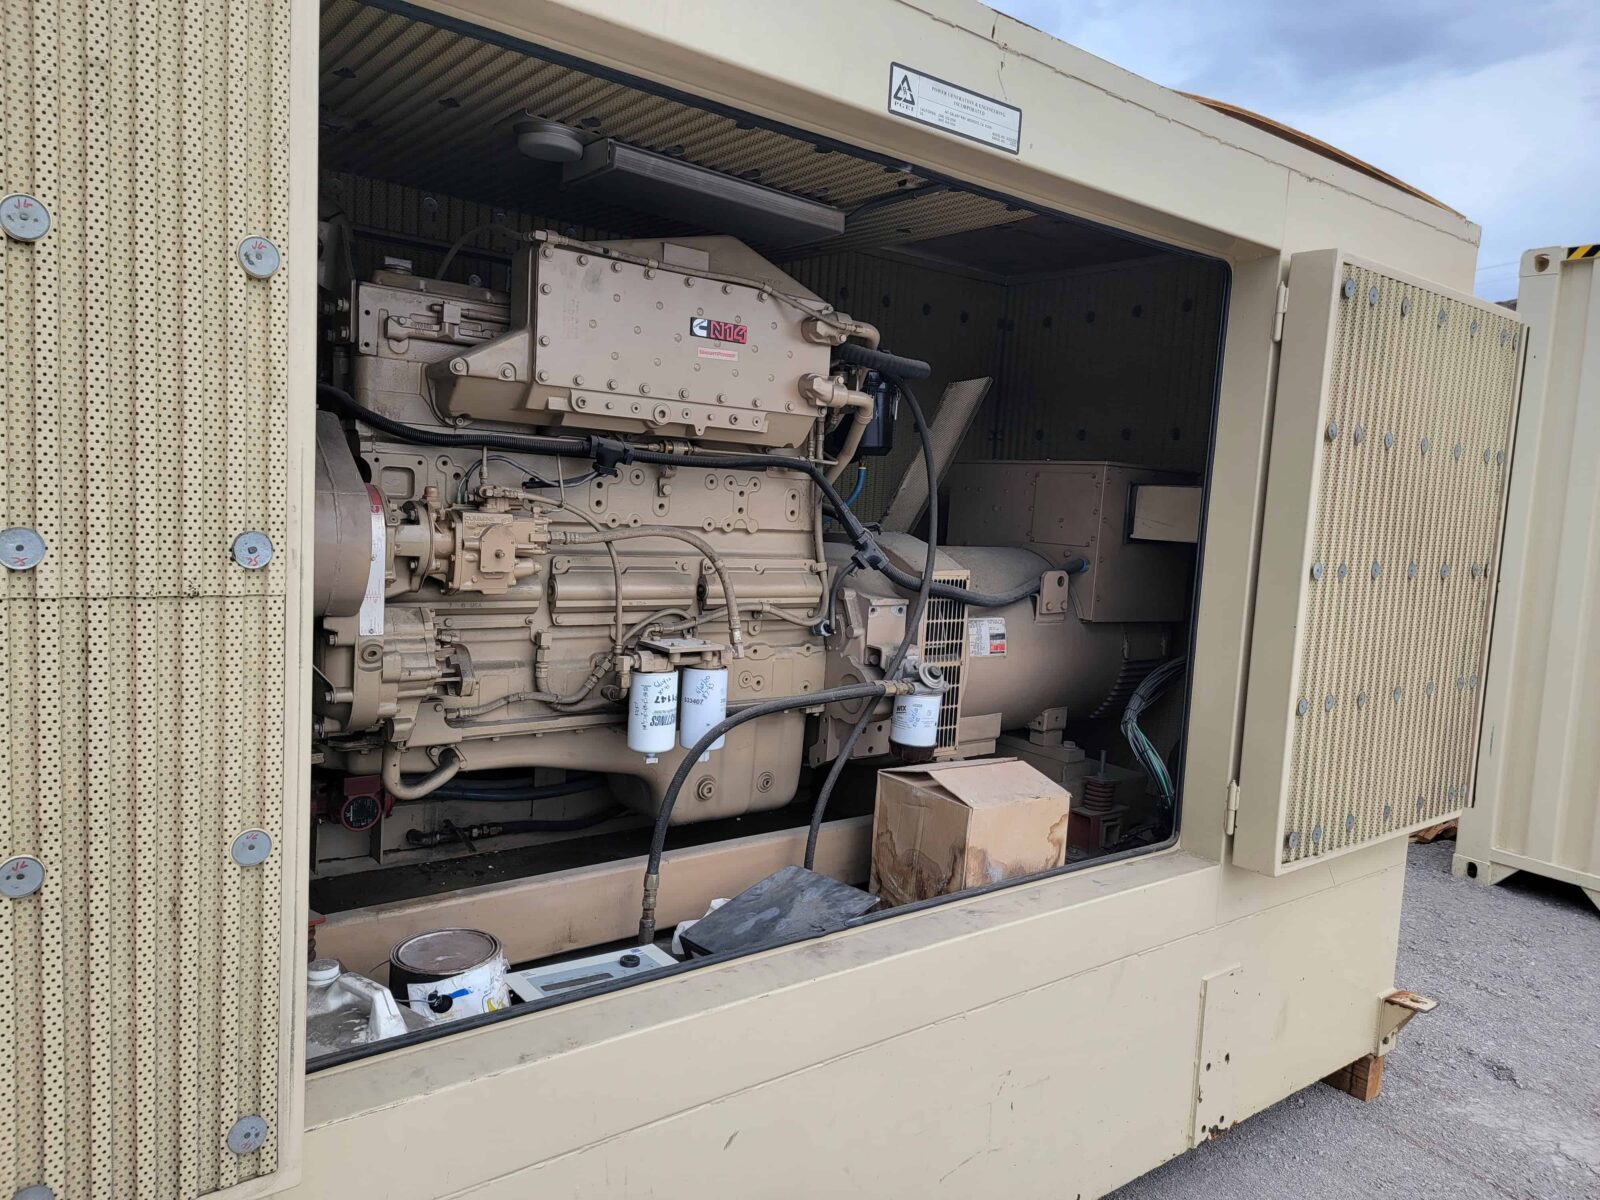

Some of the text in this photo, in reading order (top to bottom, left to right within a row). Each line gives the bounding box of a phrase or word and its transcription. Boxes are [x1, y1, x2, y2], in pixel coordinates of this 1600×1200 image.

[894, 100, 914, 112] PGEI
[931, 86, 947, 97] POWER
[948, 91, 974, 107] GENERATION
[978, 102, 1006, 117] ENGINEERING
[953, 100, 986, 116] INCORPORATED
[710, 320, 747, 344] N14
